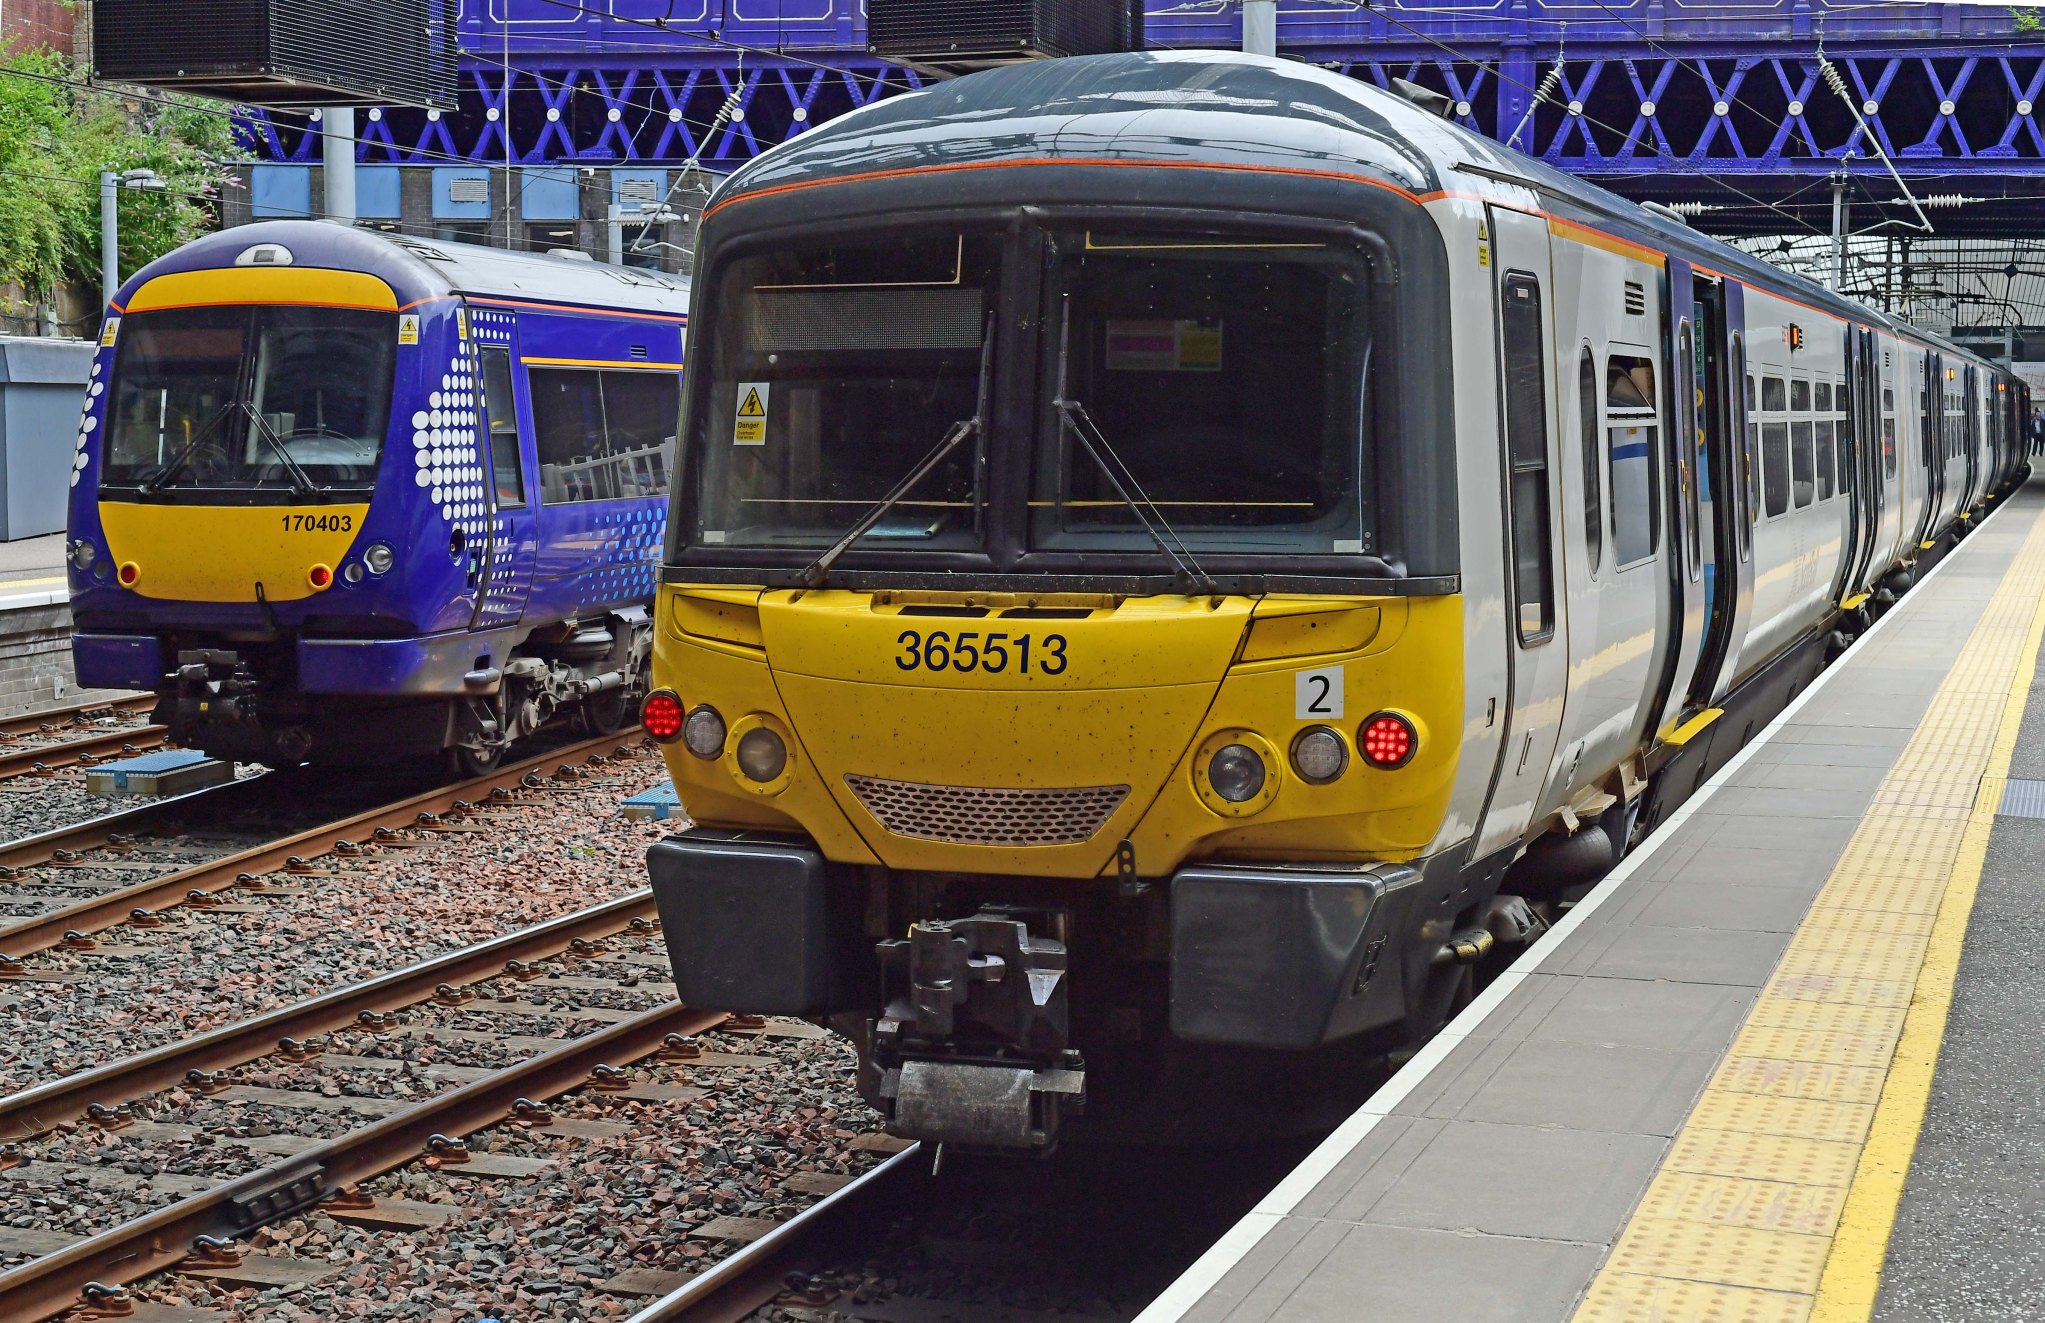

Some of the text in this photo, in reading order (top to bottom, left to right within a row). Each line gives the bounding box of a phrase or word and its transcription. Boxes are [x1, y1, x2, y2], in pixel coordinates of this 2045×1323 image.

[737, 421, 759, 429] Danger
[281, 514, 352, 532] 170403
[895, 629, 1068, 676] 365513
[1307, 674, 1332, 713] 2
